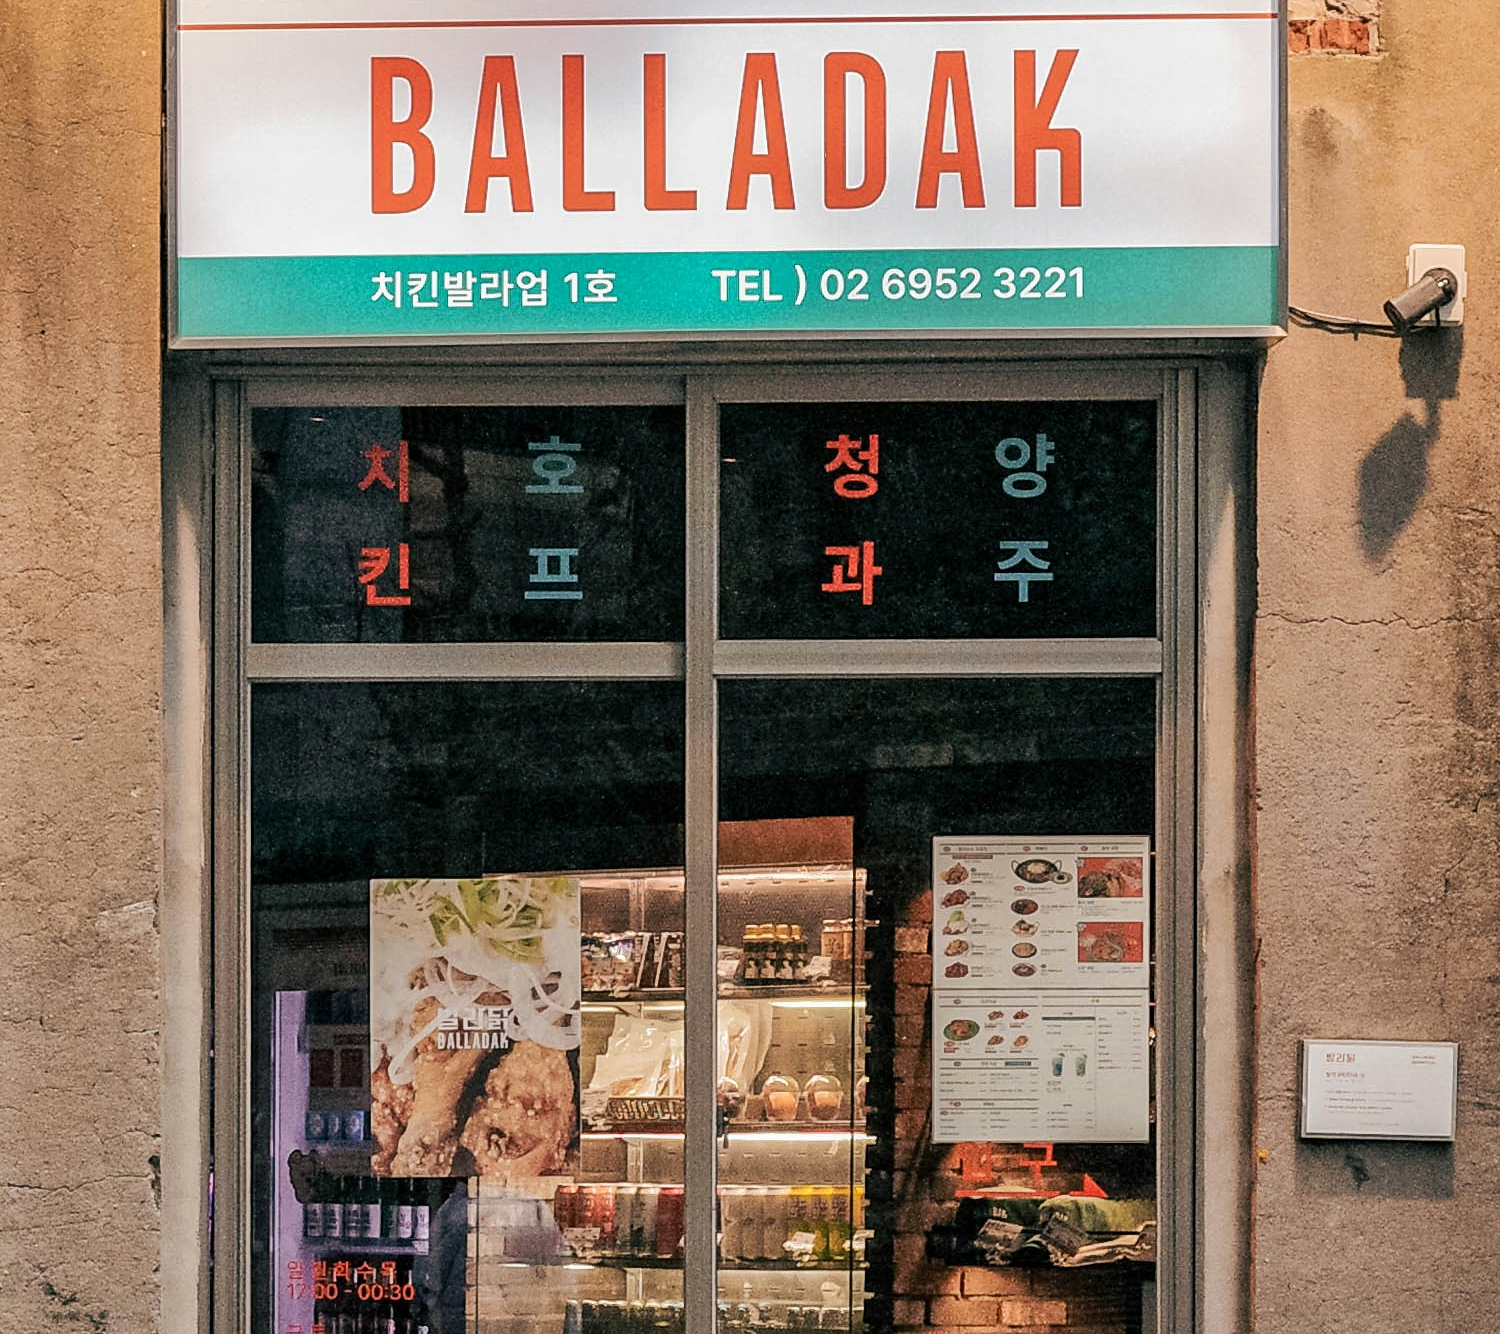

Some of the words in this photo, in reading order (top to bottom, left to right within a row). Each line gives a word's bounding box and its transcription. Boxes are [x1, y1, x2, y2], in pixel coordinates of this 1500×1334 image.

[370, 48, 1083, 215] BALLADAK
[371, 268, 550, 310] 치킨발라업
[563, 269, 618, 306] 1호
[711, 269, 782, 303] TEL
[820, 267, 869, 301] 02
[881, 266, 982, 301] 6952
[992, 264, 1085, 299] 3221
[437, 1032, 509, 1050] BALLADAK
[357, 1284, 416, 1301] 00:30
